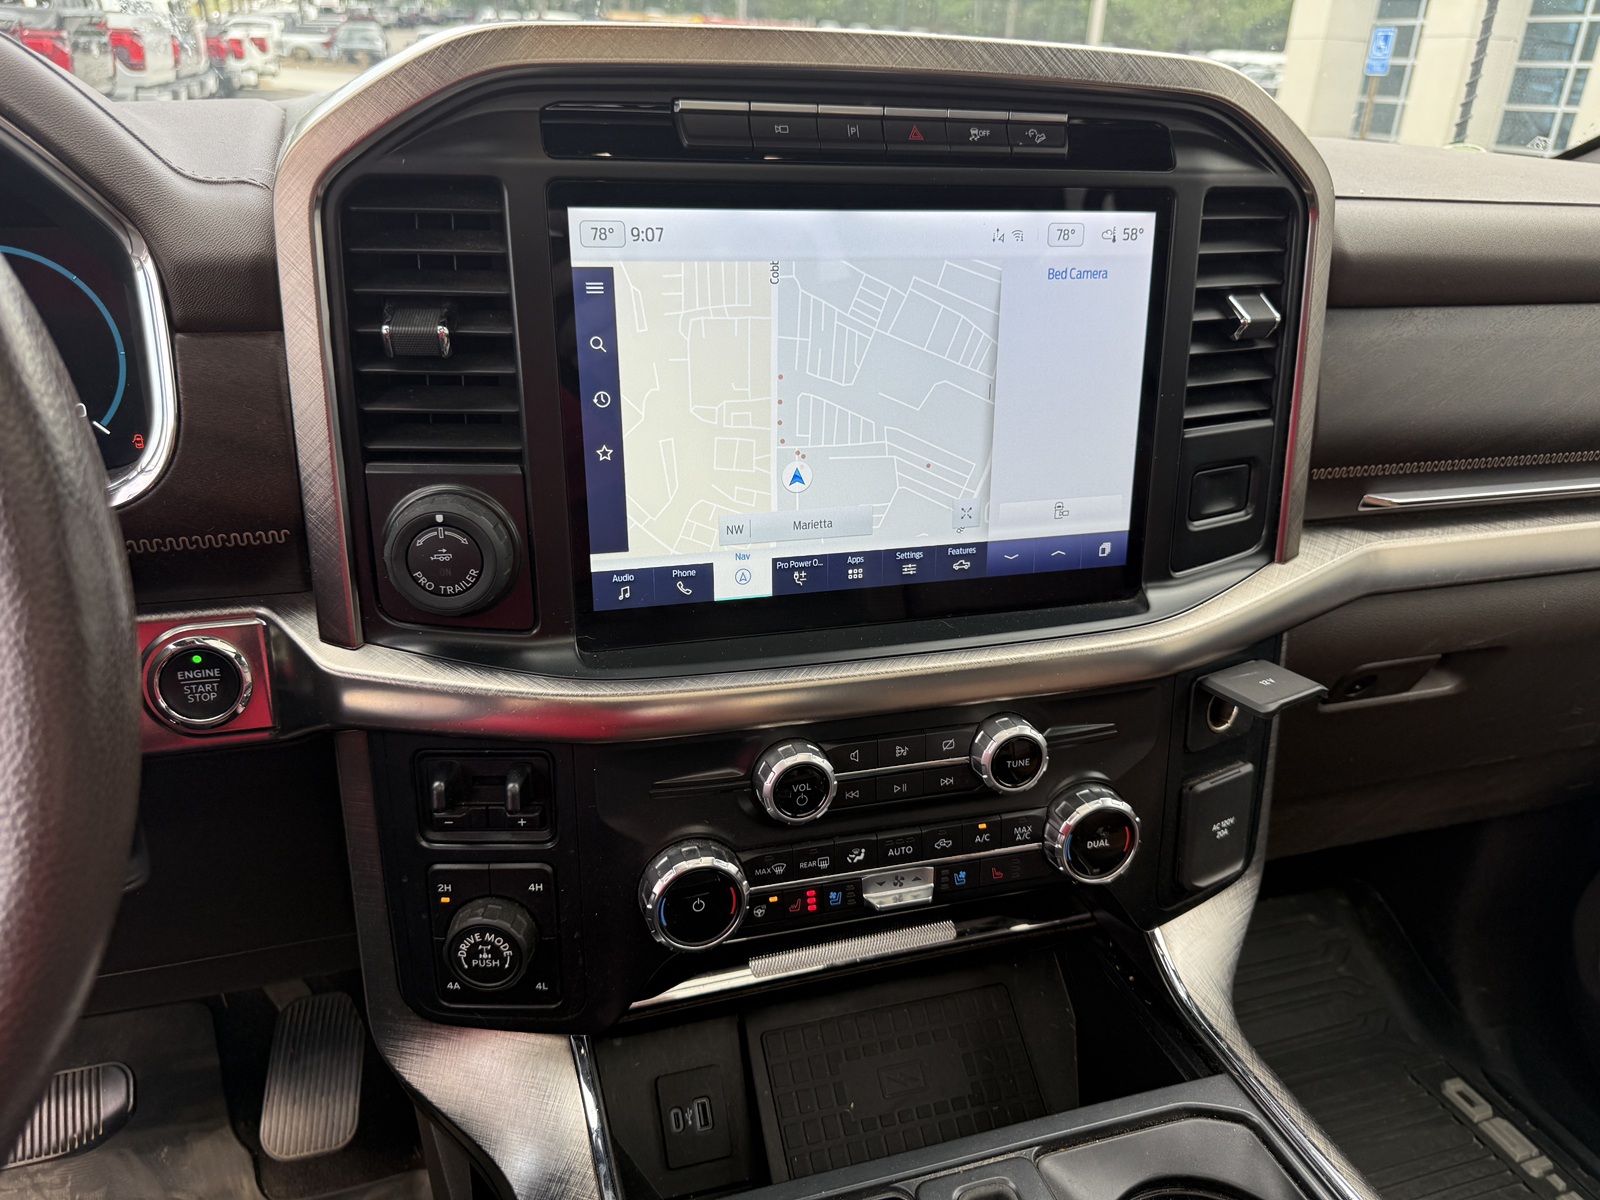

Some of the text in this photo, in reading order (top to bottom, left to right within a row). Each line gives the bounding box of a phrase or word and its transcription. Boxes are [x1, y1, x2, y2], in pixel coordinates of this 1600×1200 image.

[978, 129, 991, 138] OFF
[590, 227, 615, 241] 78°
[630, 227, 664, 242] 9:07
[1056, 228, 1076, 241] 78°
[1122, 227, 1145, 241] 58°
[1047, 267, 1109, 280] Bed Camera
[726, 524, 745, 536] NW
[793, 519, 833, 531] Marietta
[895, 551, 924, 561] Settings
[948, 546, 977, 556] Features
[735, 552, 751, 561] Nav
[847, 555, 865, 565] Apps
[776, 561, 788, 570] Pro
[789, 560, 811, 569] Power
[612, 573, 635, 583] Audio
[672, 568, 697, 578] Phone
[413, 568, 480, 595] PRO TRAILER
[177, 668, 221, 680] ENGINE
[183, 683, 219, 695] START
[187, 692, 218, 703] STOP
[1006, 758, 1031, 768] TUNE
[792, 784, 812, 793] VOL
[1013, 825, 1033, 835] MAX
[974, 833, 991, 843] A/C
[1015, 831, 1031, 841] A/C
[1087, 838, 1110, 849] DUAL
[887, 845, 914, 857] AUTO
[799, 860, 818, 869] REAR
[754, 867, 771, 876] MAX
[437, 883, 452, 893] 2H
[528, 883, 544, 892] 4H
[457, 932, 513, 958] DRIVE MODE
[472, 958, 500, 968] PUSH
[446, 981, 461, 990] 4A
[535, 981, 549, 991] 4L
